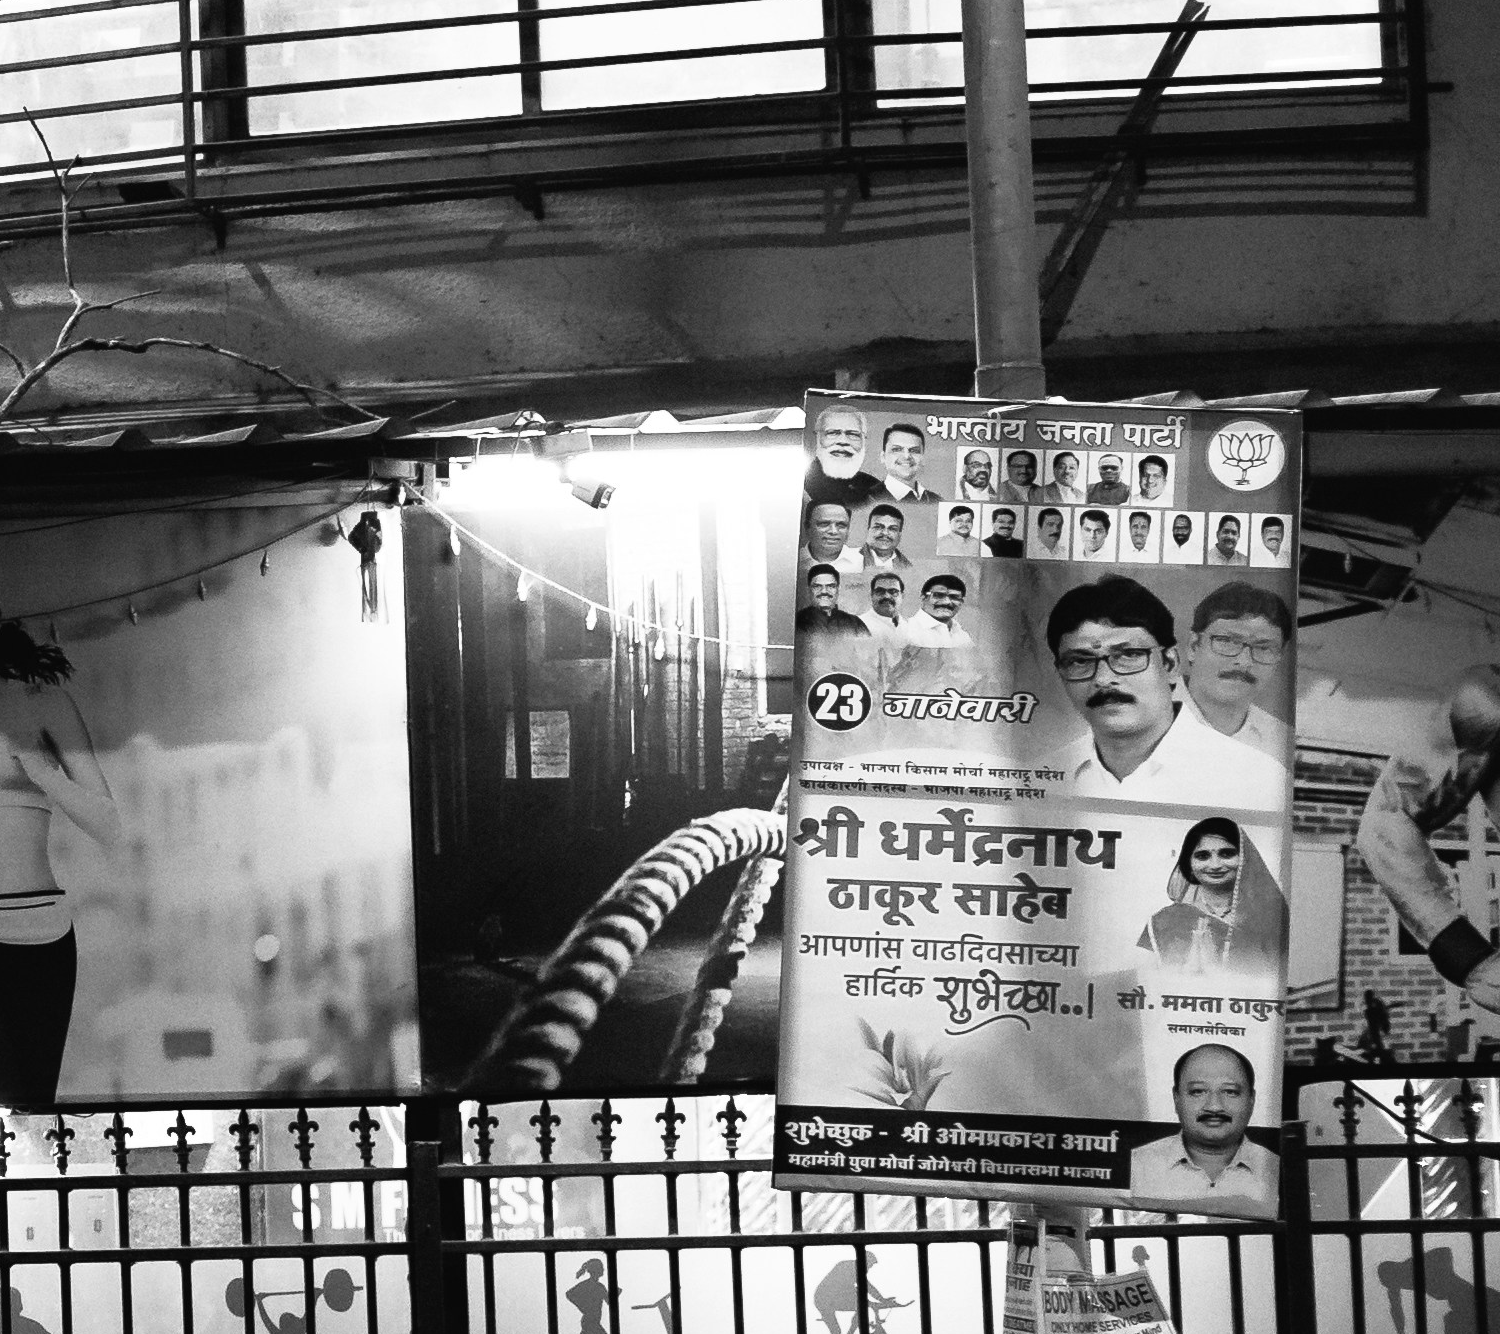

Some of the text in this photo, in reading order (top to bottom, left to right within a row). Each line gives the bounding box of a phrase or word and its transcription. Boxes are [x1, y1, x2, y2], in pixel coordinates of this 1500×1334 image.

[926, 411, 1187, 449] भारतीय जनता पार्टी
[813, 682, 1038, 725] 23 जानेवारी
[860, 762, 901, 775] भाजपा
[1034, 765, 1066, 781] प्रदेश
[924, 784, 965, 796] भाजपा
[1015, 783, 1046, 800] प्रदेश
[792, 805, 1122, 870] श्री धर्मेंद्रनाथ
[826, 872, 1073, 927] ठाकूर साहेब
[799, 931, 1080, 968] आपणांस वाढदिवसाच्या
[843, 965, 925, 998] हार्दिक
[1161, 994, 1224, 1014] ममता
[1228, 997, 1286, 1023] ठाकुर
[1167, 1020, 1247, 1037] समाजसेविका
[785, 1116, 874, 1147] शुभेच्छुक
[901, 1121, 931, 1145] श्री
[936, 1122, 1057, 1151] ओमप्रकाश
[788, 1150, 846, 1168] महामंत्री
[849, 1156, 877, 1173] युवा
[879, 1153, 915, 1170] मोर्चा
[980, 1158, 1060, 1178] विधानसभा
[1063, 1166, 1113, 1180] भाजपा
[330, 1181, 366, 1230] M
[1044, 1290, 1074, 1314] BODY
[1098, 1311, 1155, 1333] SERVICES
